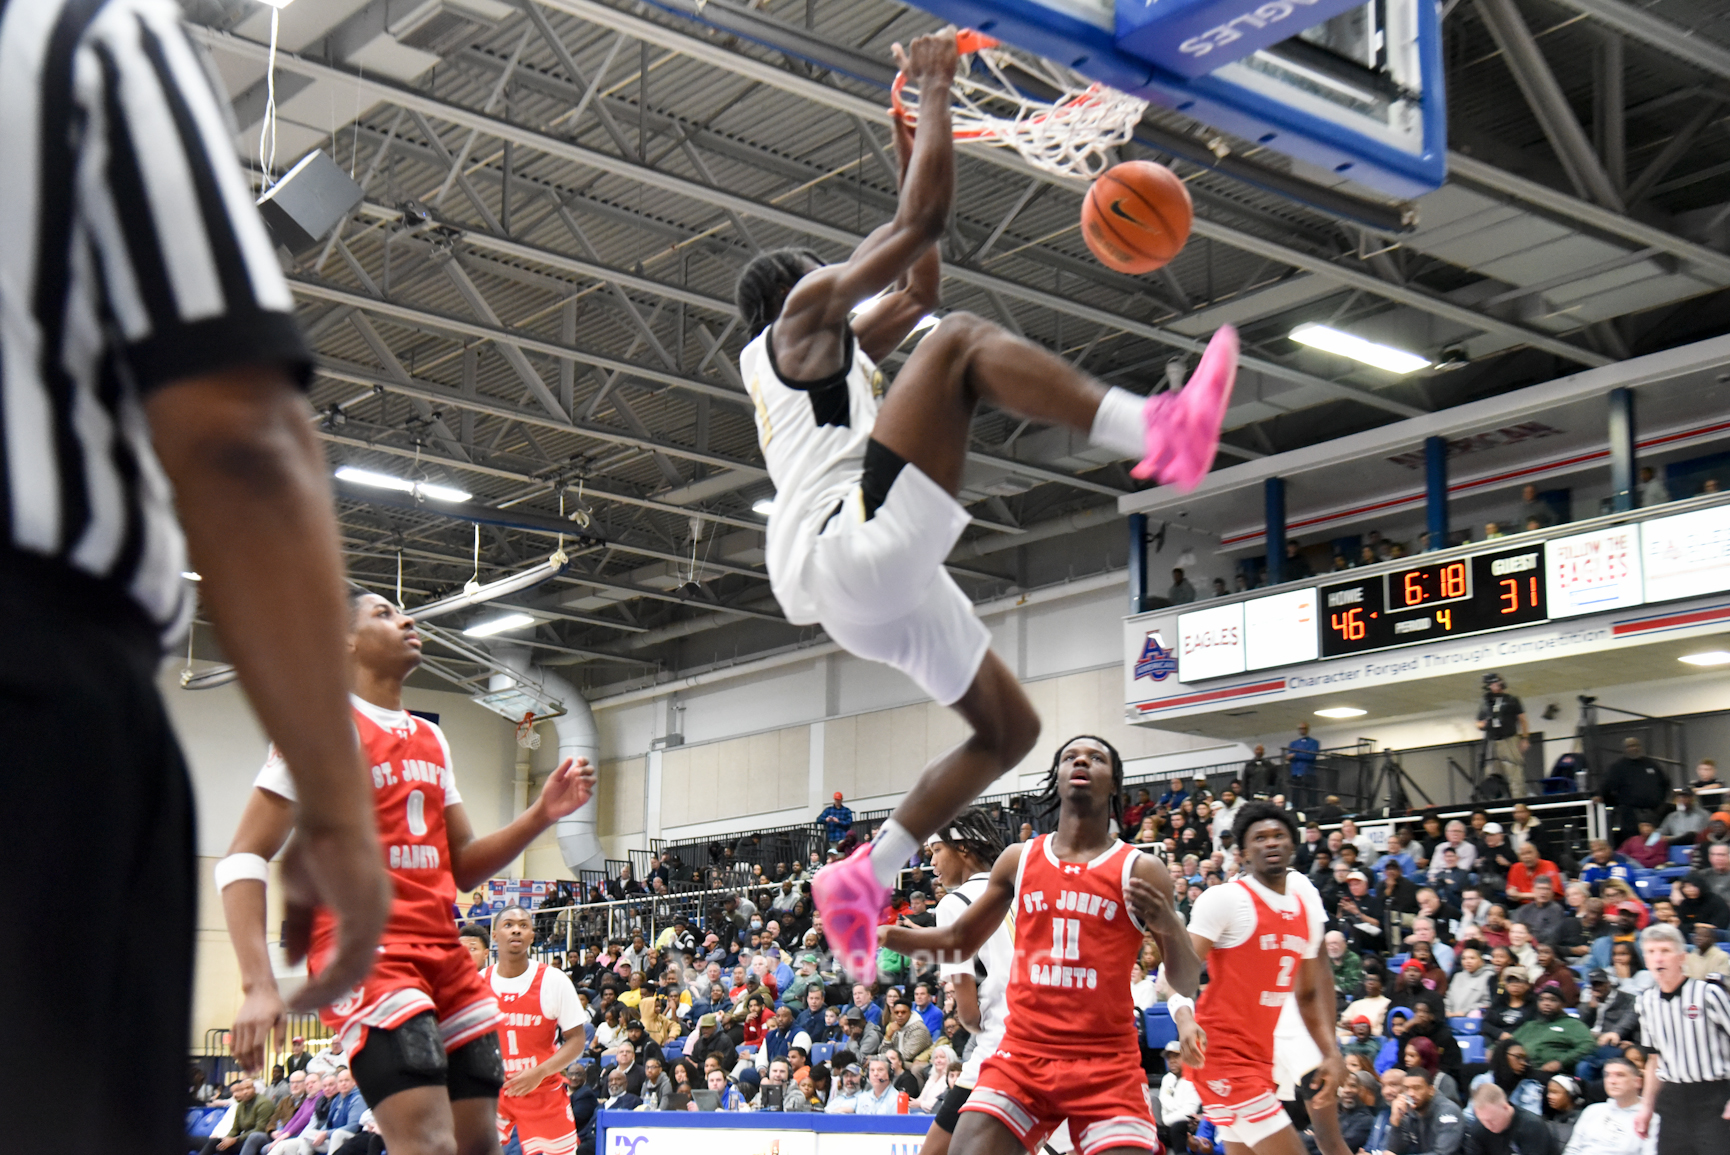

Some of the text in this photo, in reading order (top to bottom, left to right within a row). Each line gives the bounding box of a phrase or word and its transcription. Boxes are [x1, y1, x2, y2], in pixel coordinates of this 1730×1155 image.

[1491, 553, 1539, 576] GUEST
[1327, 586, 1364, 608] HOME
[1404, 563, 1466, 606] 6:18
[1500, 576, 1539, 614] 31
[1331, 607, 1366, 640] 46
[1436, 609, 1451, 631] 4
[1184, 626, 1239, 655] EAGLES
[1288, 628, 1609, 690] Character Forged Through Competition
[372, 761, 398, 789] ST.
[407, 789, 428, 836] 0
[1022, 889, 1118, 921] ST. JOHN'S
[1050, 917, 1080, 960] 11
[1030, 963, 1098, 989] CADETS
[1275, 955, 1296, 987] 2
[506, 1029, 519, 1056] 1
